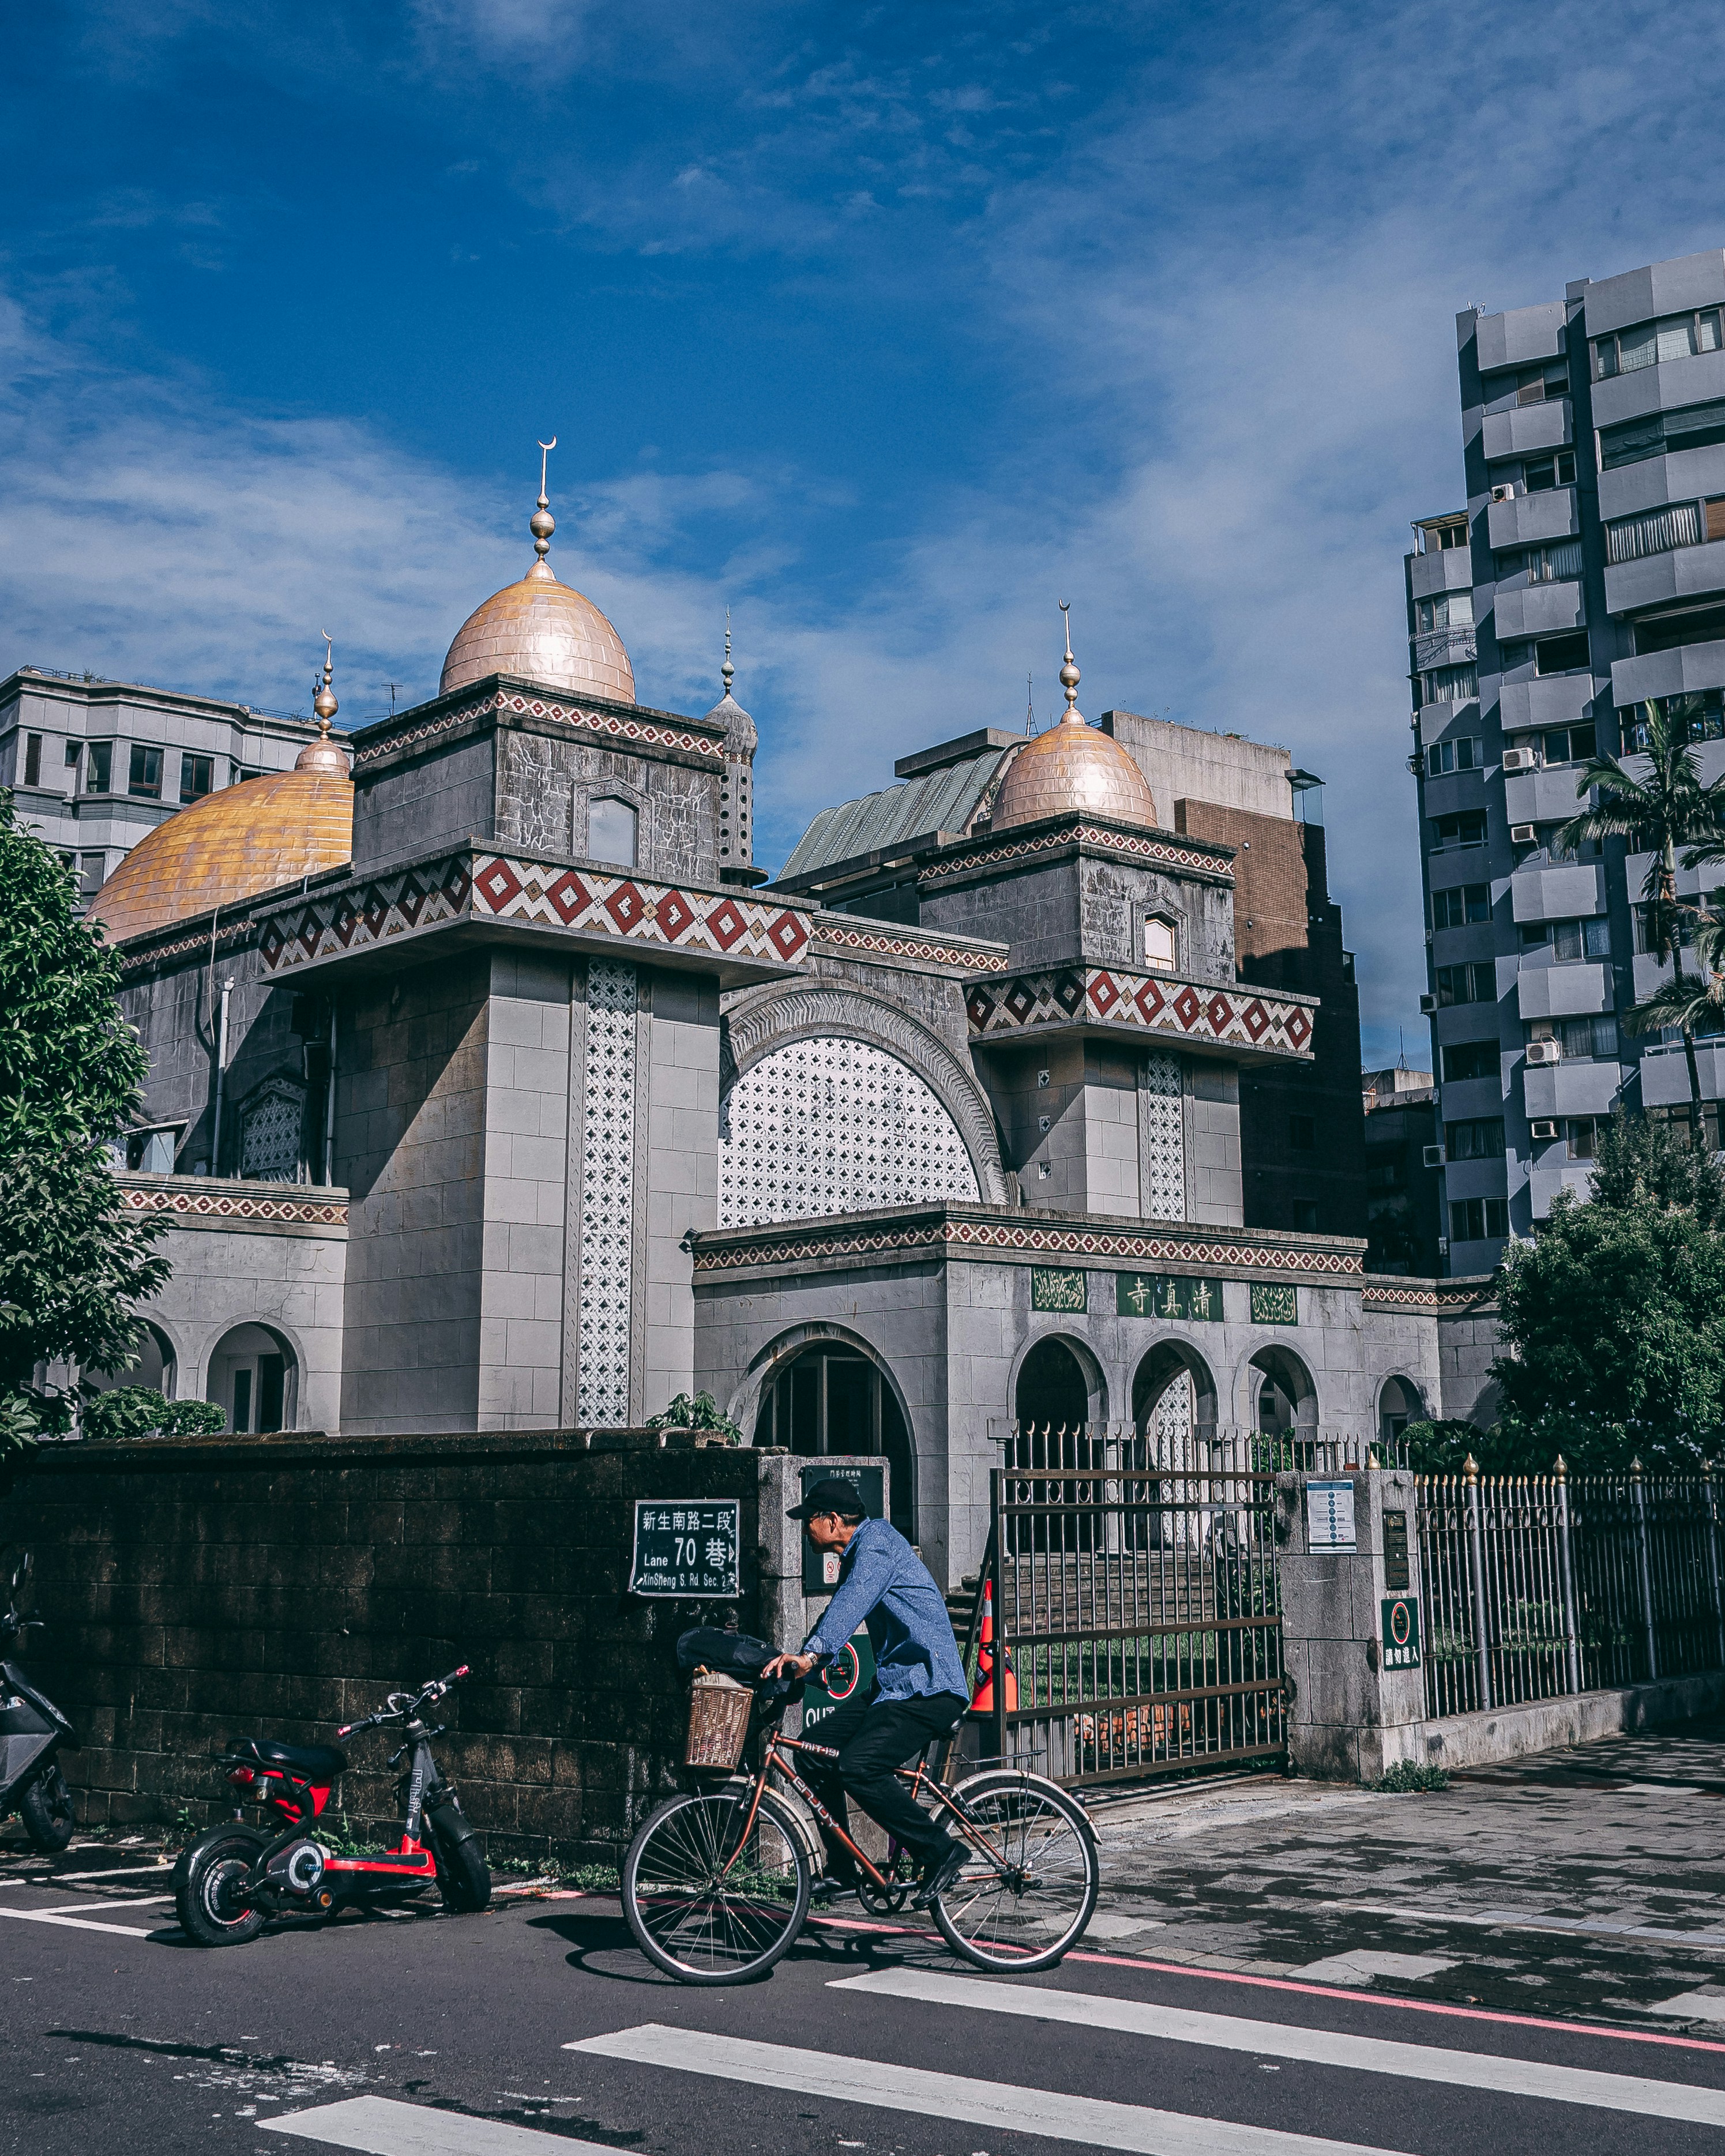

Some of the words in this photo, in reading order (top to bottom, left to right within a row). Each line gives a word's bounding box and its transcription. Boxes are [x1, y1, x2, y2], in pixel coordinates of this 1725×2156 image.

[1128, 1277, 1212, 1317] 清真寺
[643, 1511, 731, 1531] 新生南路二段
[644, 1553, 668, 1567] Lane
[675, 1537, 696, 1566] 70
[705, 1537, 727, 1567] 巷
[642, 1572, 676, 1590] XinSheng
[679, 1573, 686, 1587] S.
[689, 1572, 700, 1586] Rd.
[704, 1572, 719, 1587] Sec.
[721, 1575, 726, 1587] 2
